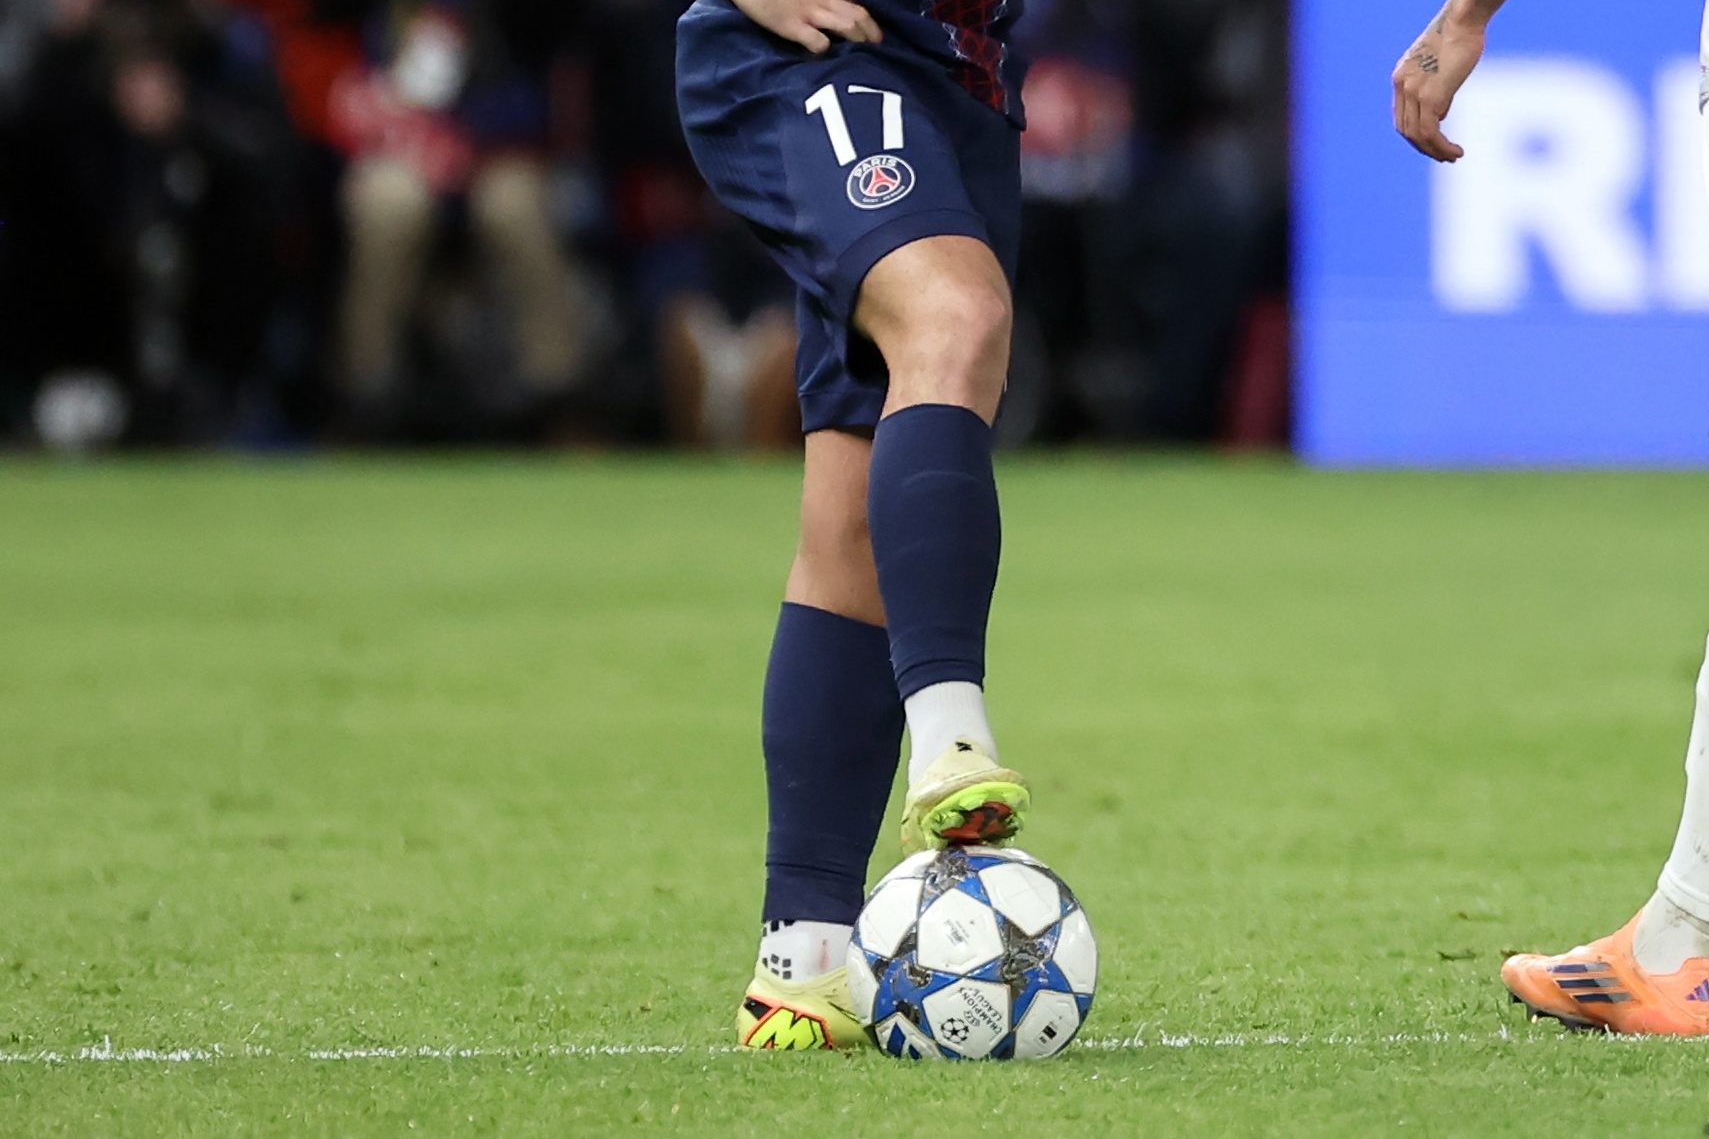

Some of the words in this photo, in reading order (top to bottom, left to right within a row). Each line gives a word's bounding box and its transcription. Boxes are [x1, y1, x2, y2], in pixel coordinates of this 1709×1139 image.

[804, 83, 905, 167] 17
[853, 157, 898, 178] PARIS
[958, 987, 1003, 1036] CHAMPIONS
